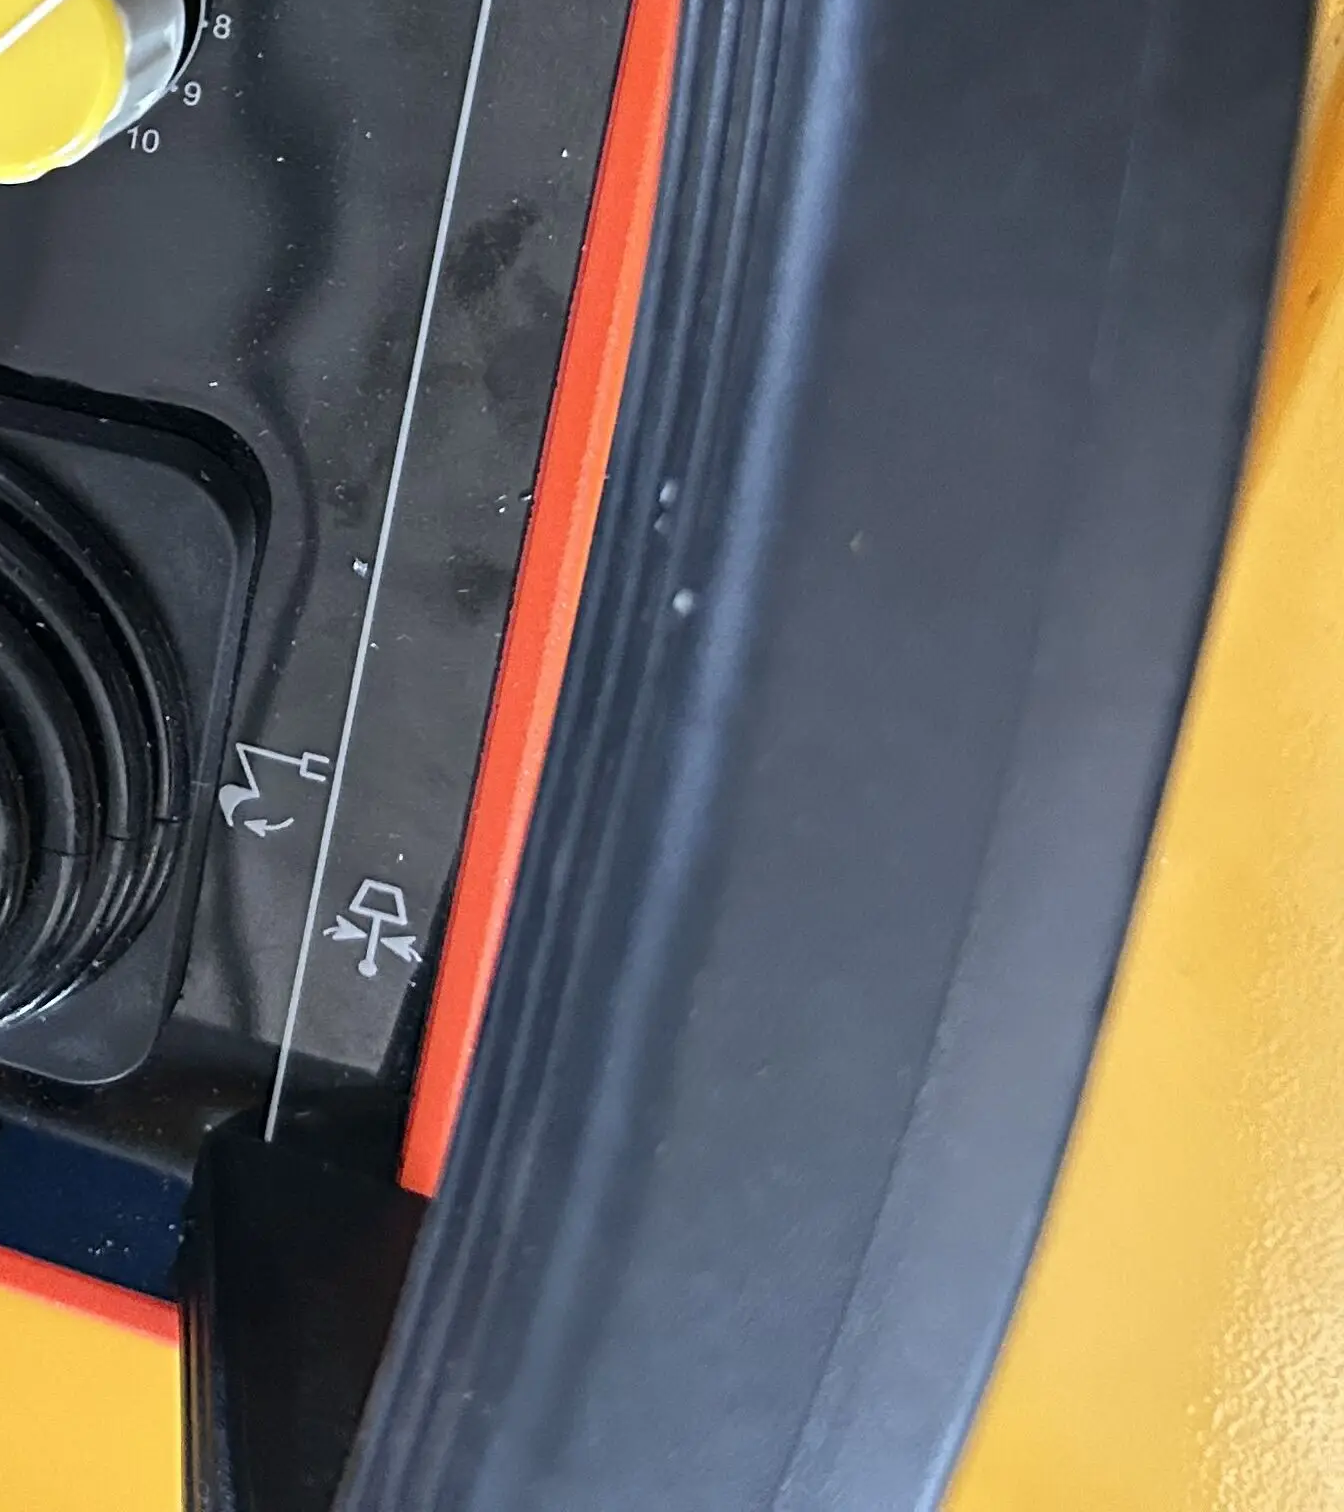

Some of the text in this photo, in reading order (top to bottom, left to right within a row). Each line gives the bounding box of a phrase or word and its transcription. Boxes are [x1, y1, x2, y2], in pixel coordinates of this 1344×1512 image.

[212, 14, 233, 41] 8
[183, 81, 203, 108] 9
[126, 126, 161, 155] 10
